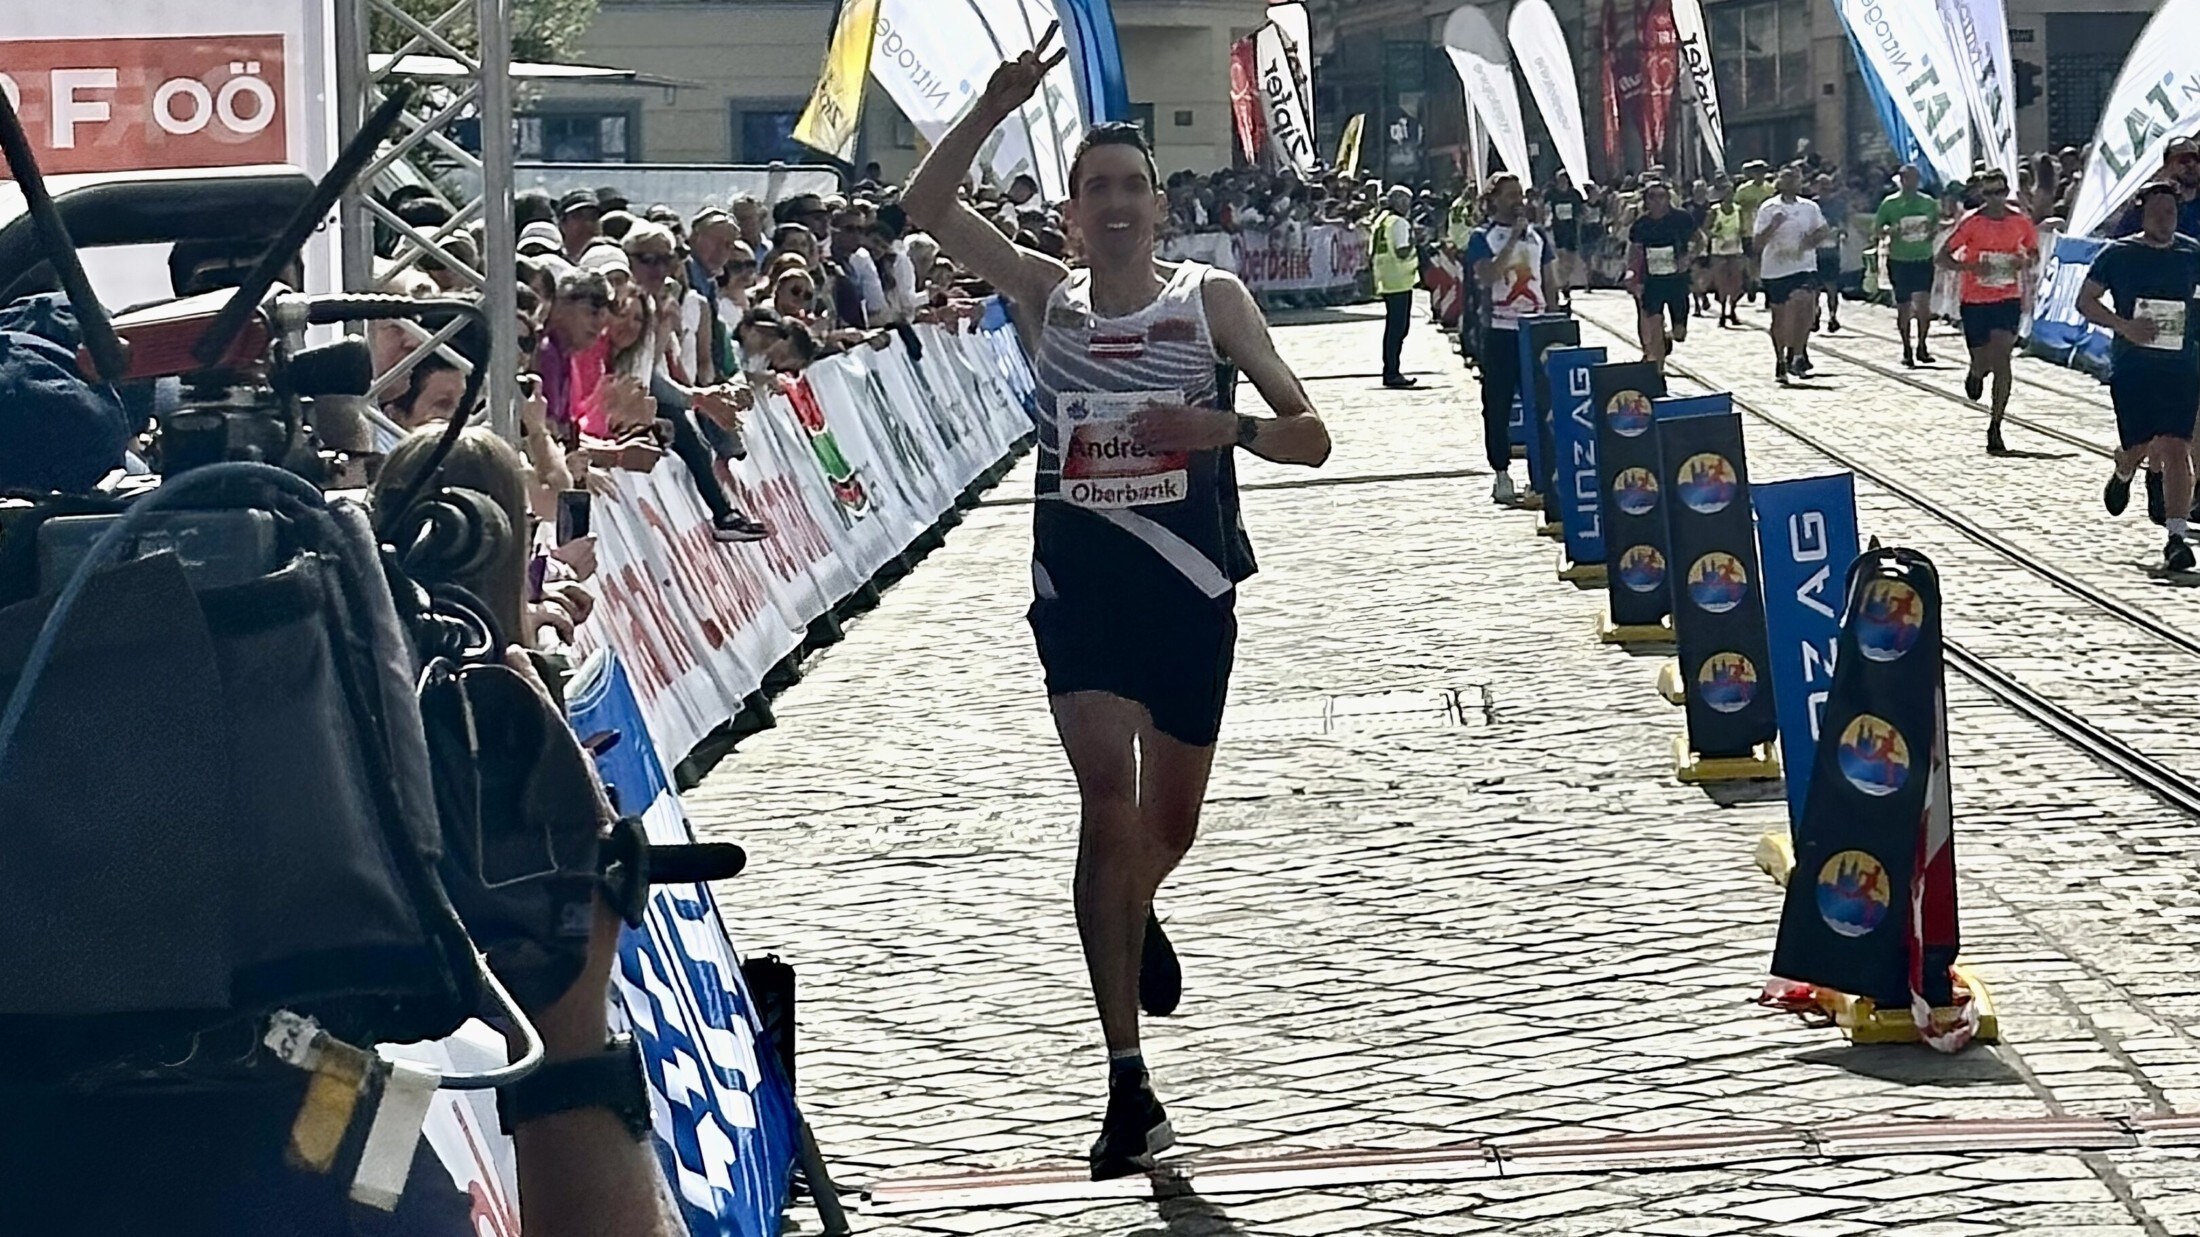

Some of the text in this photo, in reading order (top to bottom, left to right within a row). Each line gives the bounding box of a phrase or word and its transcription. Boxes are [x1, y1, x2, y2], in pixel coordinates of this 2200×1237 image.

[2100, 80, 2180, 180] LAT
[1071, 478, 1178, 503] Oberbank
[1569, 367, 1600, 539] LINZ AG
[1789, 511, 1836, 619] AG
